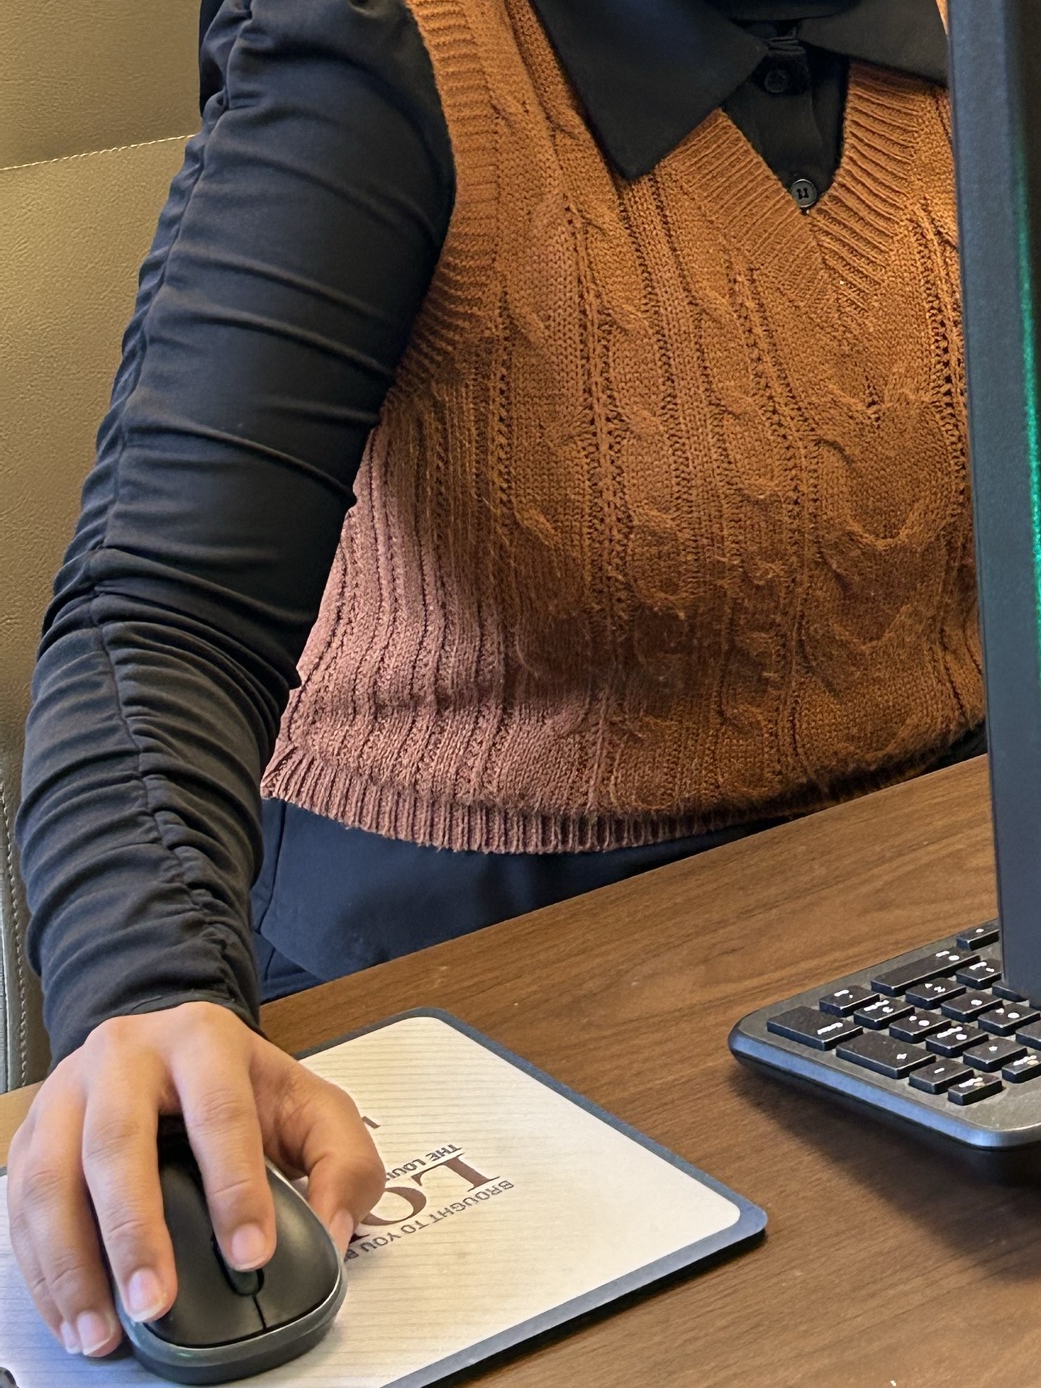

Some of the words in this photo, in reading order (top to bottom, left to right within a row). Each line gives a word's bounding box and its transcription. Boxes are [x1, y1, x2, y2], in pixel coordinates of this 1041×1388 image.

[426, 1144, 463, 1162] THE
[386, 1158, 427, 1182] LOUI
[349, 1152, 500, 1244] LO
[431, 1180, 514, 1224] BROUGHT
[400, 1219, 429, 1234] TO
[361, 1232, 402, 1254] YOU
